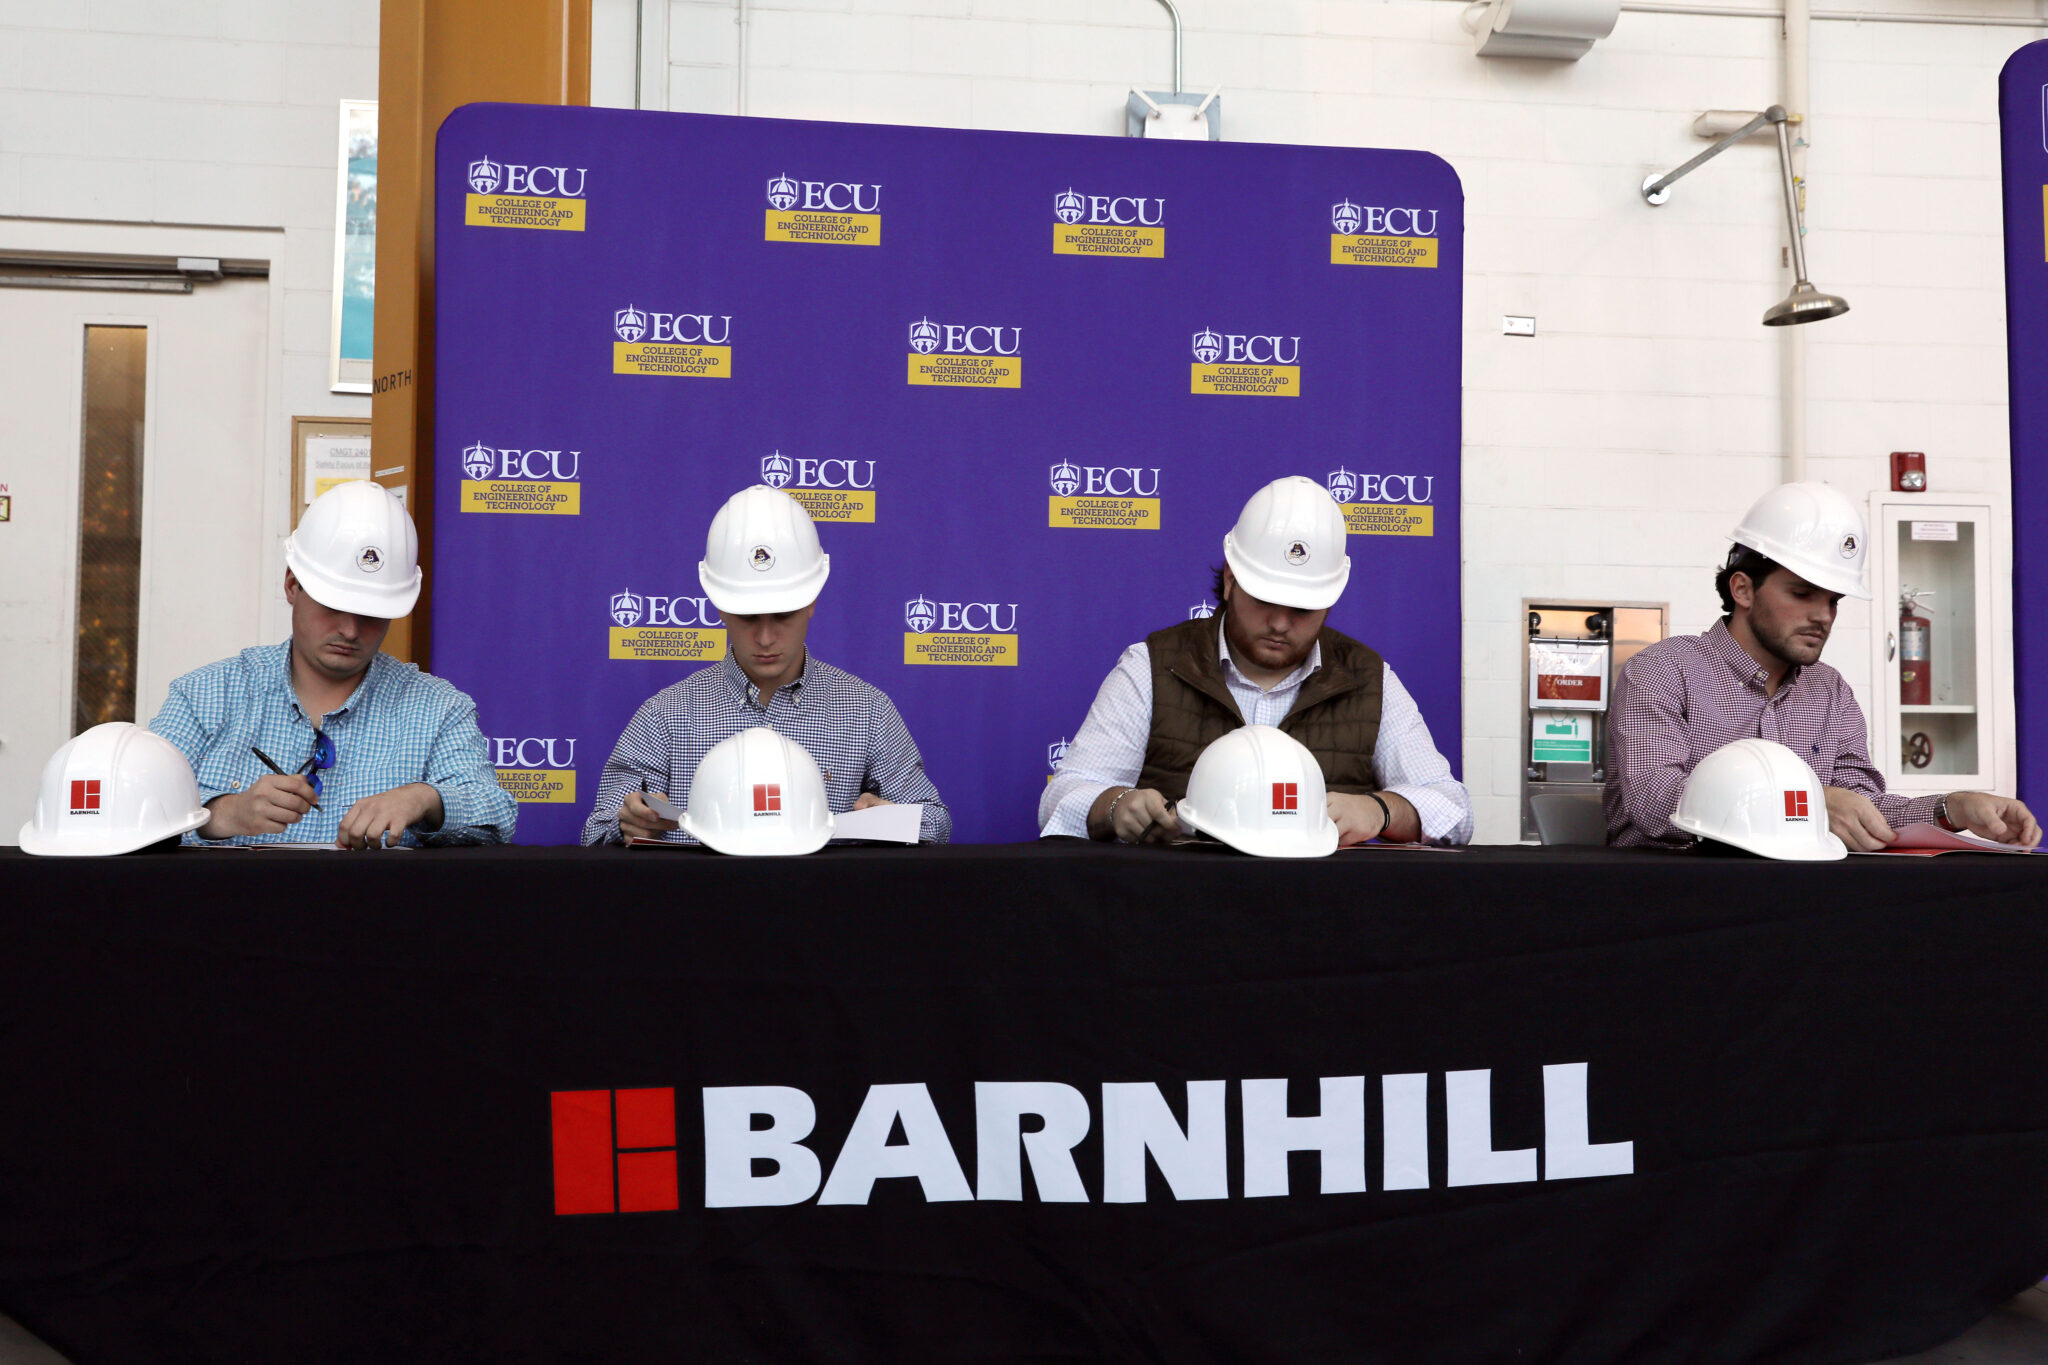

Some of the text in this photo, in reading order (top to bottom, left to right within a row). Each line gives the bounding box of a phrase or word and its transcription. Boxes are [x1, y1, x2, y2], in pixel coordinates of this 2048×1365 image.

[505, 165, 587, 196] ECU
[803, 182, 881, 211] ECU
[496, 199, 556, 209] COLLEGE OF
[479, 206, 573, 219] ENGINEERING AND
[1089, 196, 1164, 225] ECU
[491, 215, 560, 226] TECHNOLOGY
[794, 214, 852, 224] COLLEGE OF
[1365, 207, 1438, 235] ECU
[778, 223, 845, 232] ENGINEERING
[789, 231, 856, 241] TECHNOLOGY
[1081, 228, 1123, 237] COLLEGE
[1066, 236, 1153, 246] ENGINEERING AND
[1358, 239, 1397, 247] COLLEGE
[1077, 244, 1141, 254] TECHNOLOGY
[1343, 245, 1426, 256] ENGINEERING AND
[1353, 254, 1415, 263] TECHNOLOGY
[651, 313, 731, 343] ECU
[944, 325, 1022, 354] ECU
[643, 347, 687, 356] COLLEGE
[1226, 335, 1300, 363] ECU
[627, 355, 718, 365] ENGINEERING AND
[936, 358, 993, 367] COLLEGE OF
[638, 364, 706, 373] TECHNOLOGY
[920, 365, 986, 375] ENGINEERING
[373, 368, 412, 394] NORTH
[932, 375, 997, 384] TECHNOLOGY
[1203, 375, 1288, 385] ENGINEERING AND
[1214, 384, 1277, 393] TECHNOLOGY
[499, 449, 581, 479] ECU
[796, 459, 876, 488] ECU
[1084, 467, 1160, 495] ECU
[491, 484, 551, 493] COLLEGE OF
[1361, 474, 1433, 502] ECU
[474, 492, 543, 501] ENGINEERING
[789, 492, 847, 501] COLLEGE OF
[486, 502, 555, 510] TECHNOLOGY
[800, 501, 840, 510] EERING
[1077, 501, 1118, 509] COLLEGE
[807, 511, 851, 519] NOLOGY
[1061, 508, 1126, 517] ENGINEERING
[1353, 507, 1393, 515] COLLEGE
[1072, 517, 1137, 525] TECHNOLOGY
[1344, 515, 1422, 524] NGINEERING AND
[1349, 523, 1411, 532] TECHNOLOGY
[647, 597, 722, 626] ECU
[940, 603, 1018, 631] ECU
[639, 631, 698, 640] COLLEGE OF
[622, 639, 714, 648] ENGINEERING AND
[933, 636, 990, 645] COLLEGE OF
[634, 648, 702, 657] TECHNOLOGY
[917, 645, 983, 653] ENGINEERING
[928, 653, 994, 661] TECHNOLOGY
[493, 738, 576, 767] ECU
[541, 782, 563, 790] AND
[511, 790, 551, 798] NOLOGY
[703, 1062, 1634, 1208] BARNHILL
